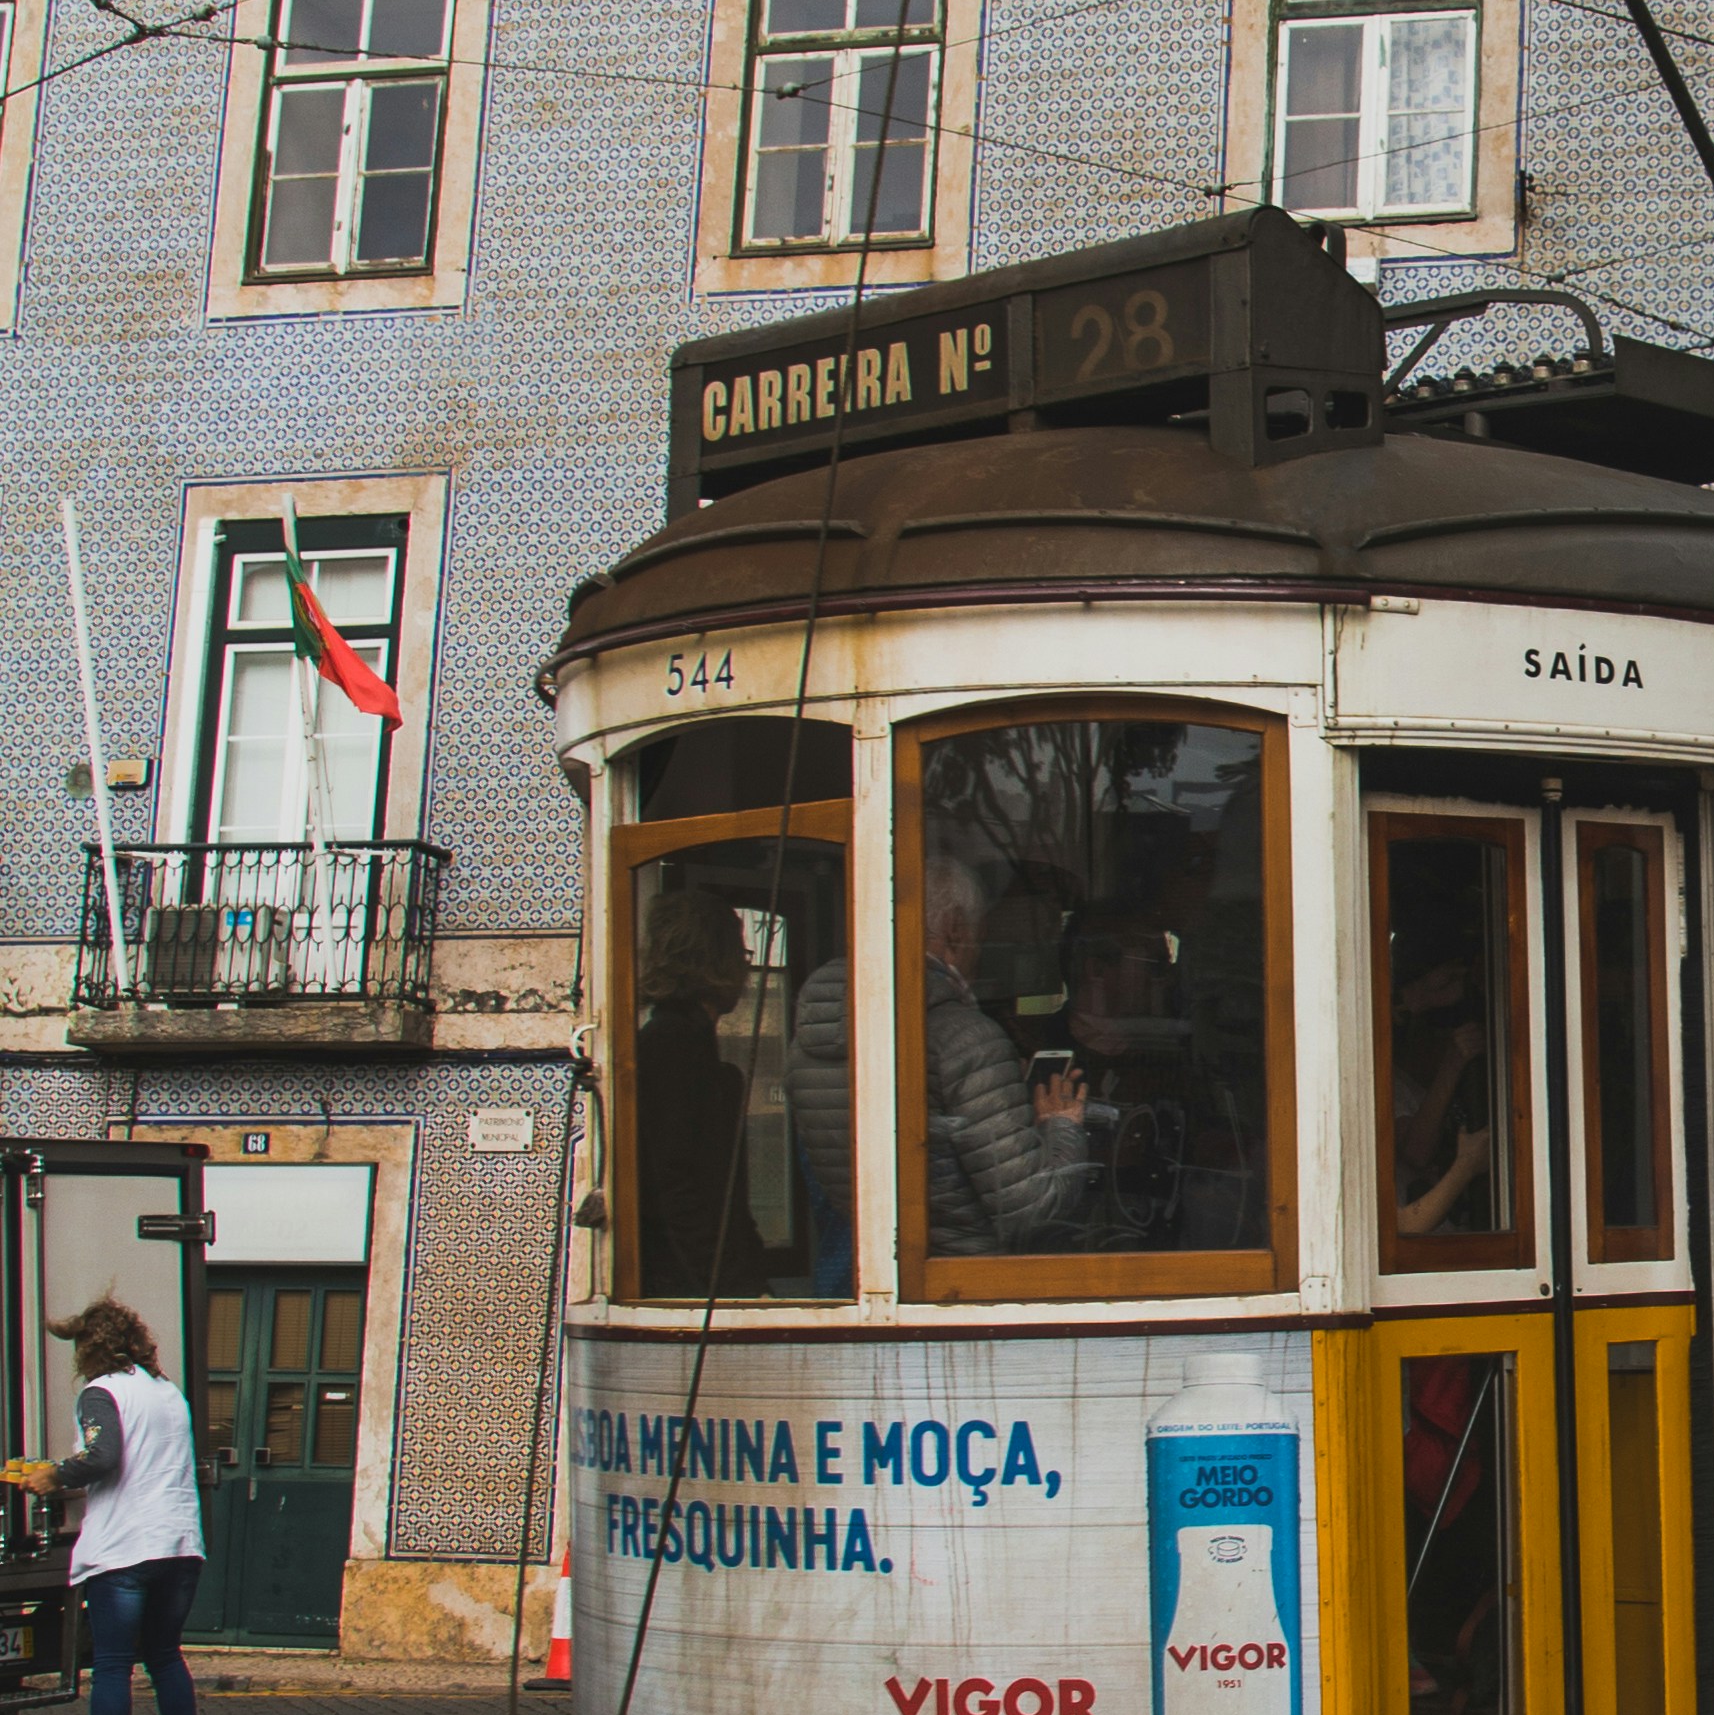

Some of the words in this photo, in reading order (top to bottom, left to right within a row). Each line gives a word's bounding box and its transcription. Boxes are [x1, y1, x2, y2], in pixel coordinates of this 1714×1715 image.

[1070, 288, 1175, 383] 28
[702, 341, 913, 443] CARREIRA
[665, 647, 735, 697] 544
[1523, 642, 1645, 690] SAÍDA
[247, 1133, 266, 1153] 68
[1197, 1422, 1214, 1432] DO
[1245, 1420, 1292, 1431] PORTUGAL
[640, 1413, 800, 1484] MENINA
[815, 1420, 844, 1486] E
[863, 1419, 1062, 1507] MOÇA,
[1195, 1464, 1259, 1487] MEIO
[1179, 1486, 1274, 1509] GORDO
[606, 1492, 894, 1575] FRESQUINHA.
[1166, 1641, 1288, 1673] VIGOR
[1216, 1678, 1243, 1689] 1951
